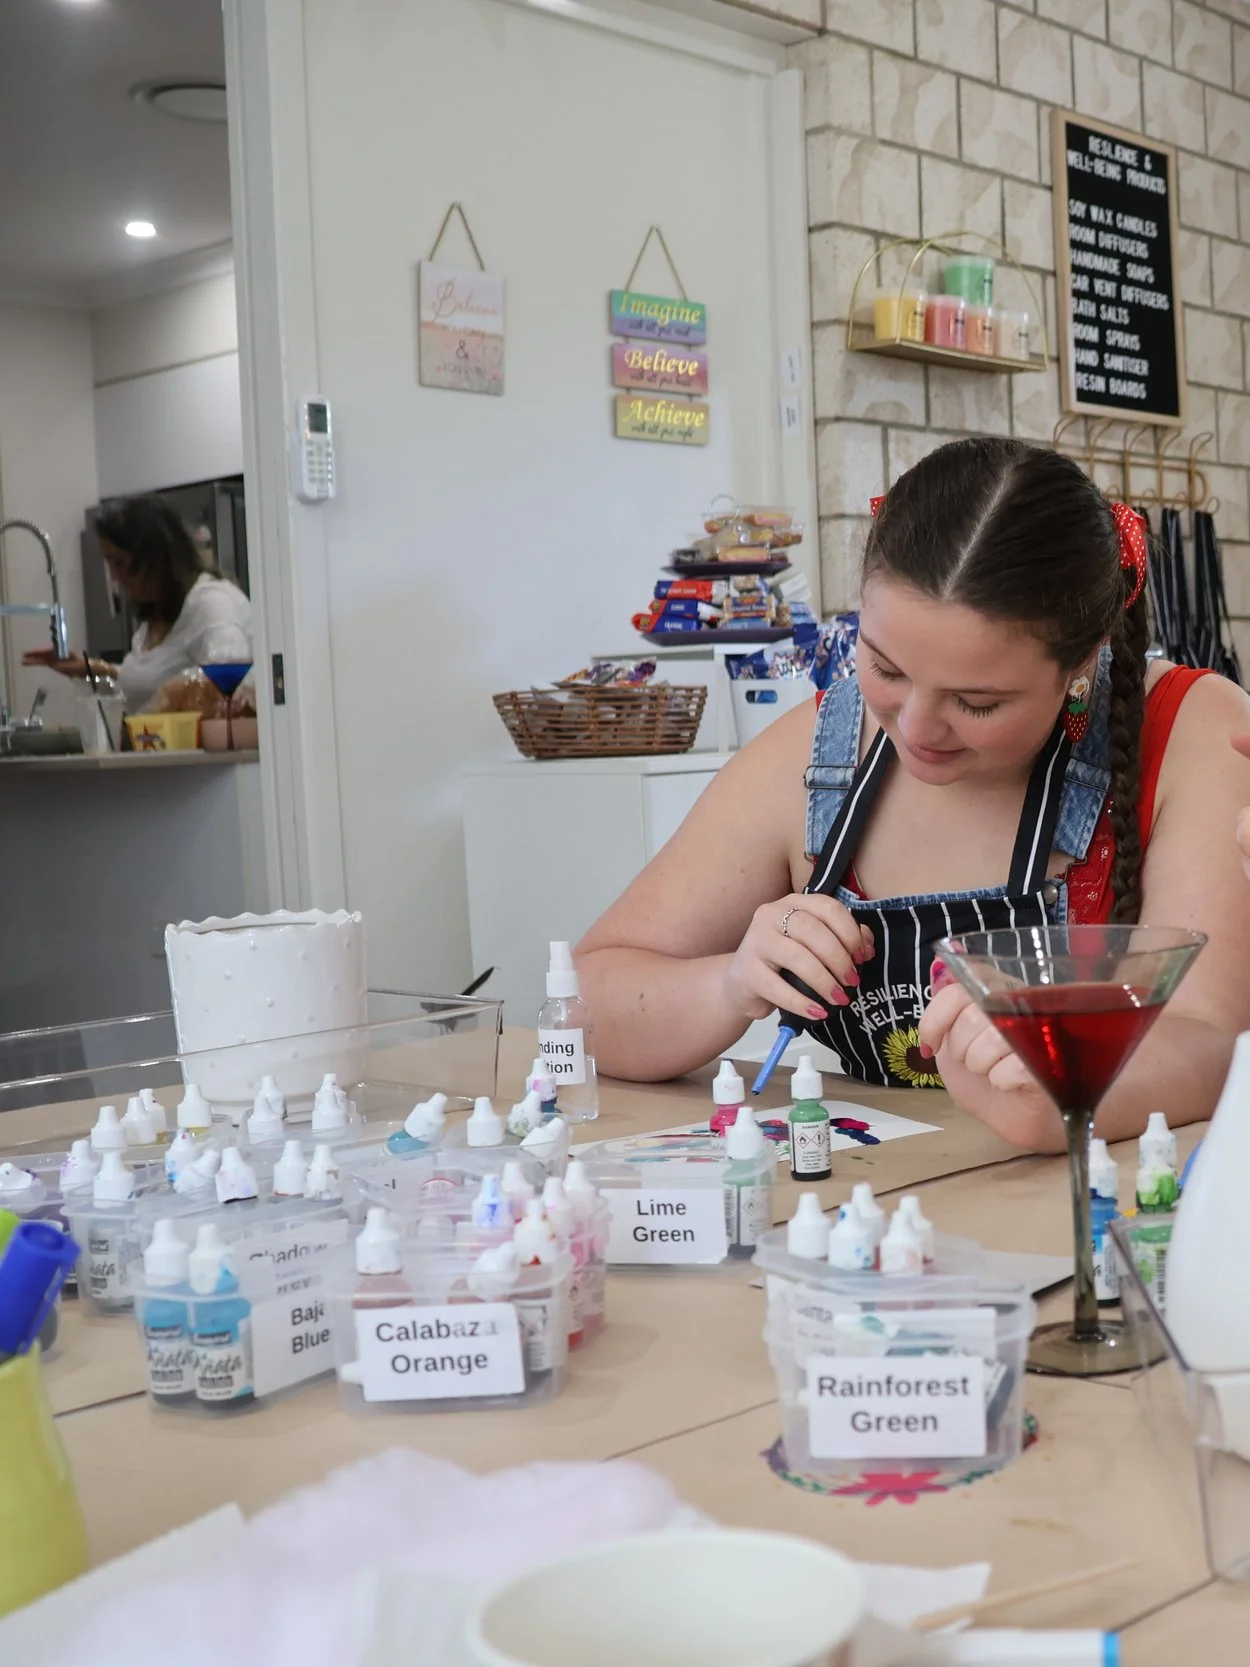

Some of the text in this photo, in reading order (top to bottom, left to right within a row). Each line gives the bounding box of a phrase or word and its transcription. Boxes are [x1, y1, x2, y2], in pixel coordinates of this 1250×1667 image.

[1069, 198, 1158, 238] SOY WAX CANDLES
[1069, 222, 1149, 259] ROOM DIFFUSERS
[1126, 262, 1155, 284] SOAPS
[1093, 278, 1117, 298] VENT
[1121, 284, 1170, 310] DIFFUSERS
[620, 292, 701, 327] Imagine
[1100, 303, 1130, 325] SALTS
[456, 339, 468, 360] &
[1073, 322, 1140, 351] ROOM SPRAYS
[624, 348, 699, 376] Believe
[1075, 348, 1149, 376] HAND SANITISER
[1076, 371, 1146, 400] RESIN BOARDS
[622, 400, 705, 428] Achieve
[850, 984, 933, 1018] RESILIENC
[859, 1004, 924, 1036] WELL-B
[540, 1041, 574, 1057] nding
[546, 1060, 574, 1074] tion
[636, 1199, 687, 1216] Lime
[632, 1226, 694, 1242] Green
[292, 1328, 331, 1355] Blue
[376, 1318, 498, 1342] Calabaza
[391, 1352, 489, 1376] Orange
[817, 1374, 970, 1398] Rainforest
[850, 1410, 939, 1434] Green
